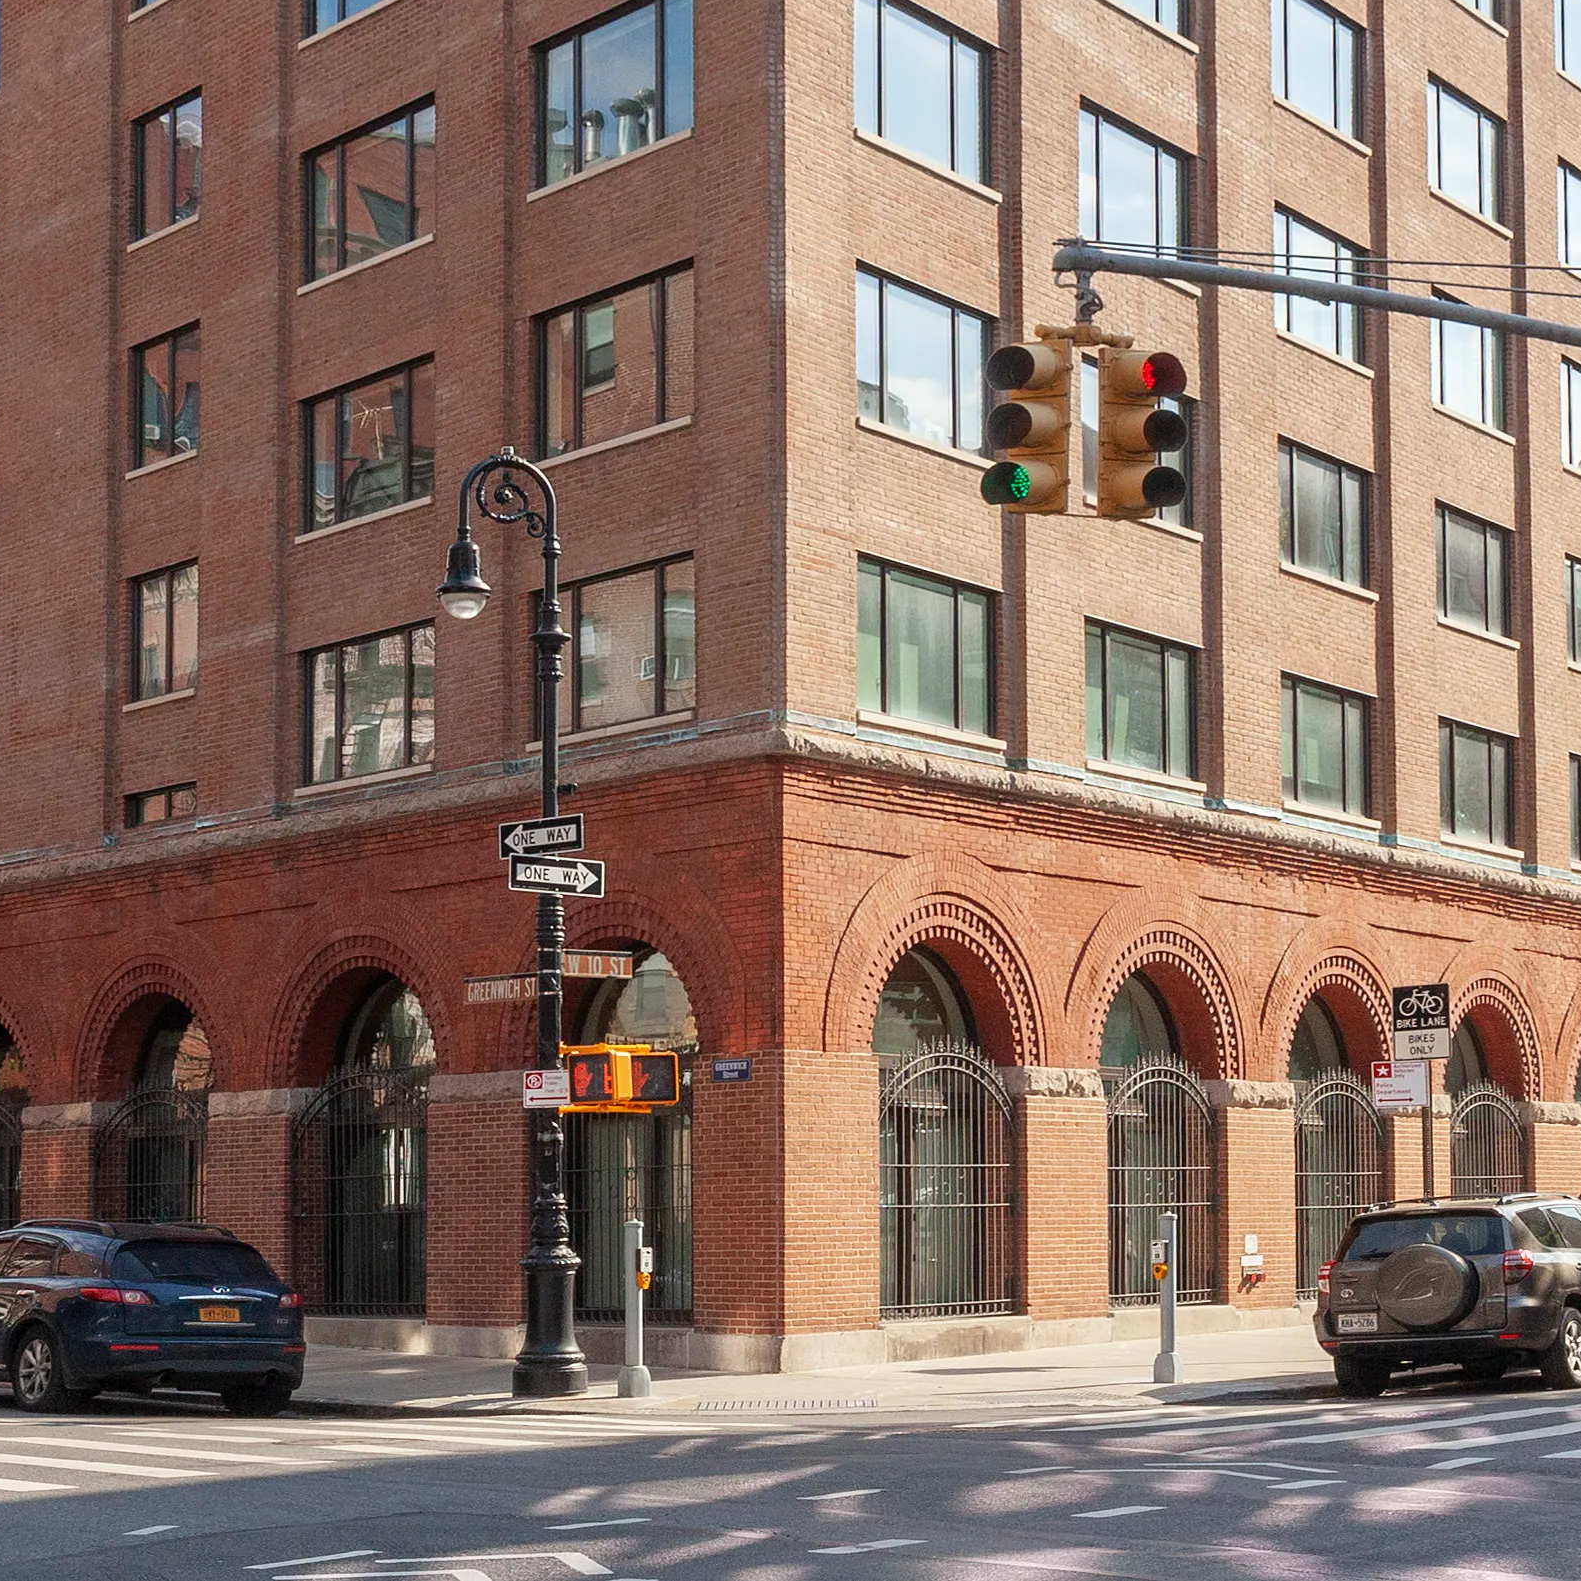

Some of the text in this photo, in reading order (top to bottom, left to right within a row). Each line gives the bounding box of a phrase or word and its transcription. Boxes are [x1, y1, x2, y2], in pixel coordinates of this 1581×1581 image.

[512, 826, 572, 847] ONE WAY
[524, 866, 589, 885] ONE WAY
[568, 955, 626, 977] W 10 ST
[467, 977, 537, 1002] GREENWICH ST
[1396, 1016, 1447, 1029] BIKE LANE
[1408, 1033, 1436, 1044] BIKES
[1409, 1045, 1435, 1055] ONLY
